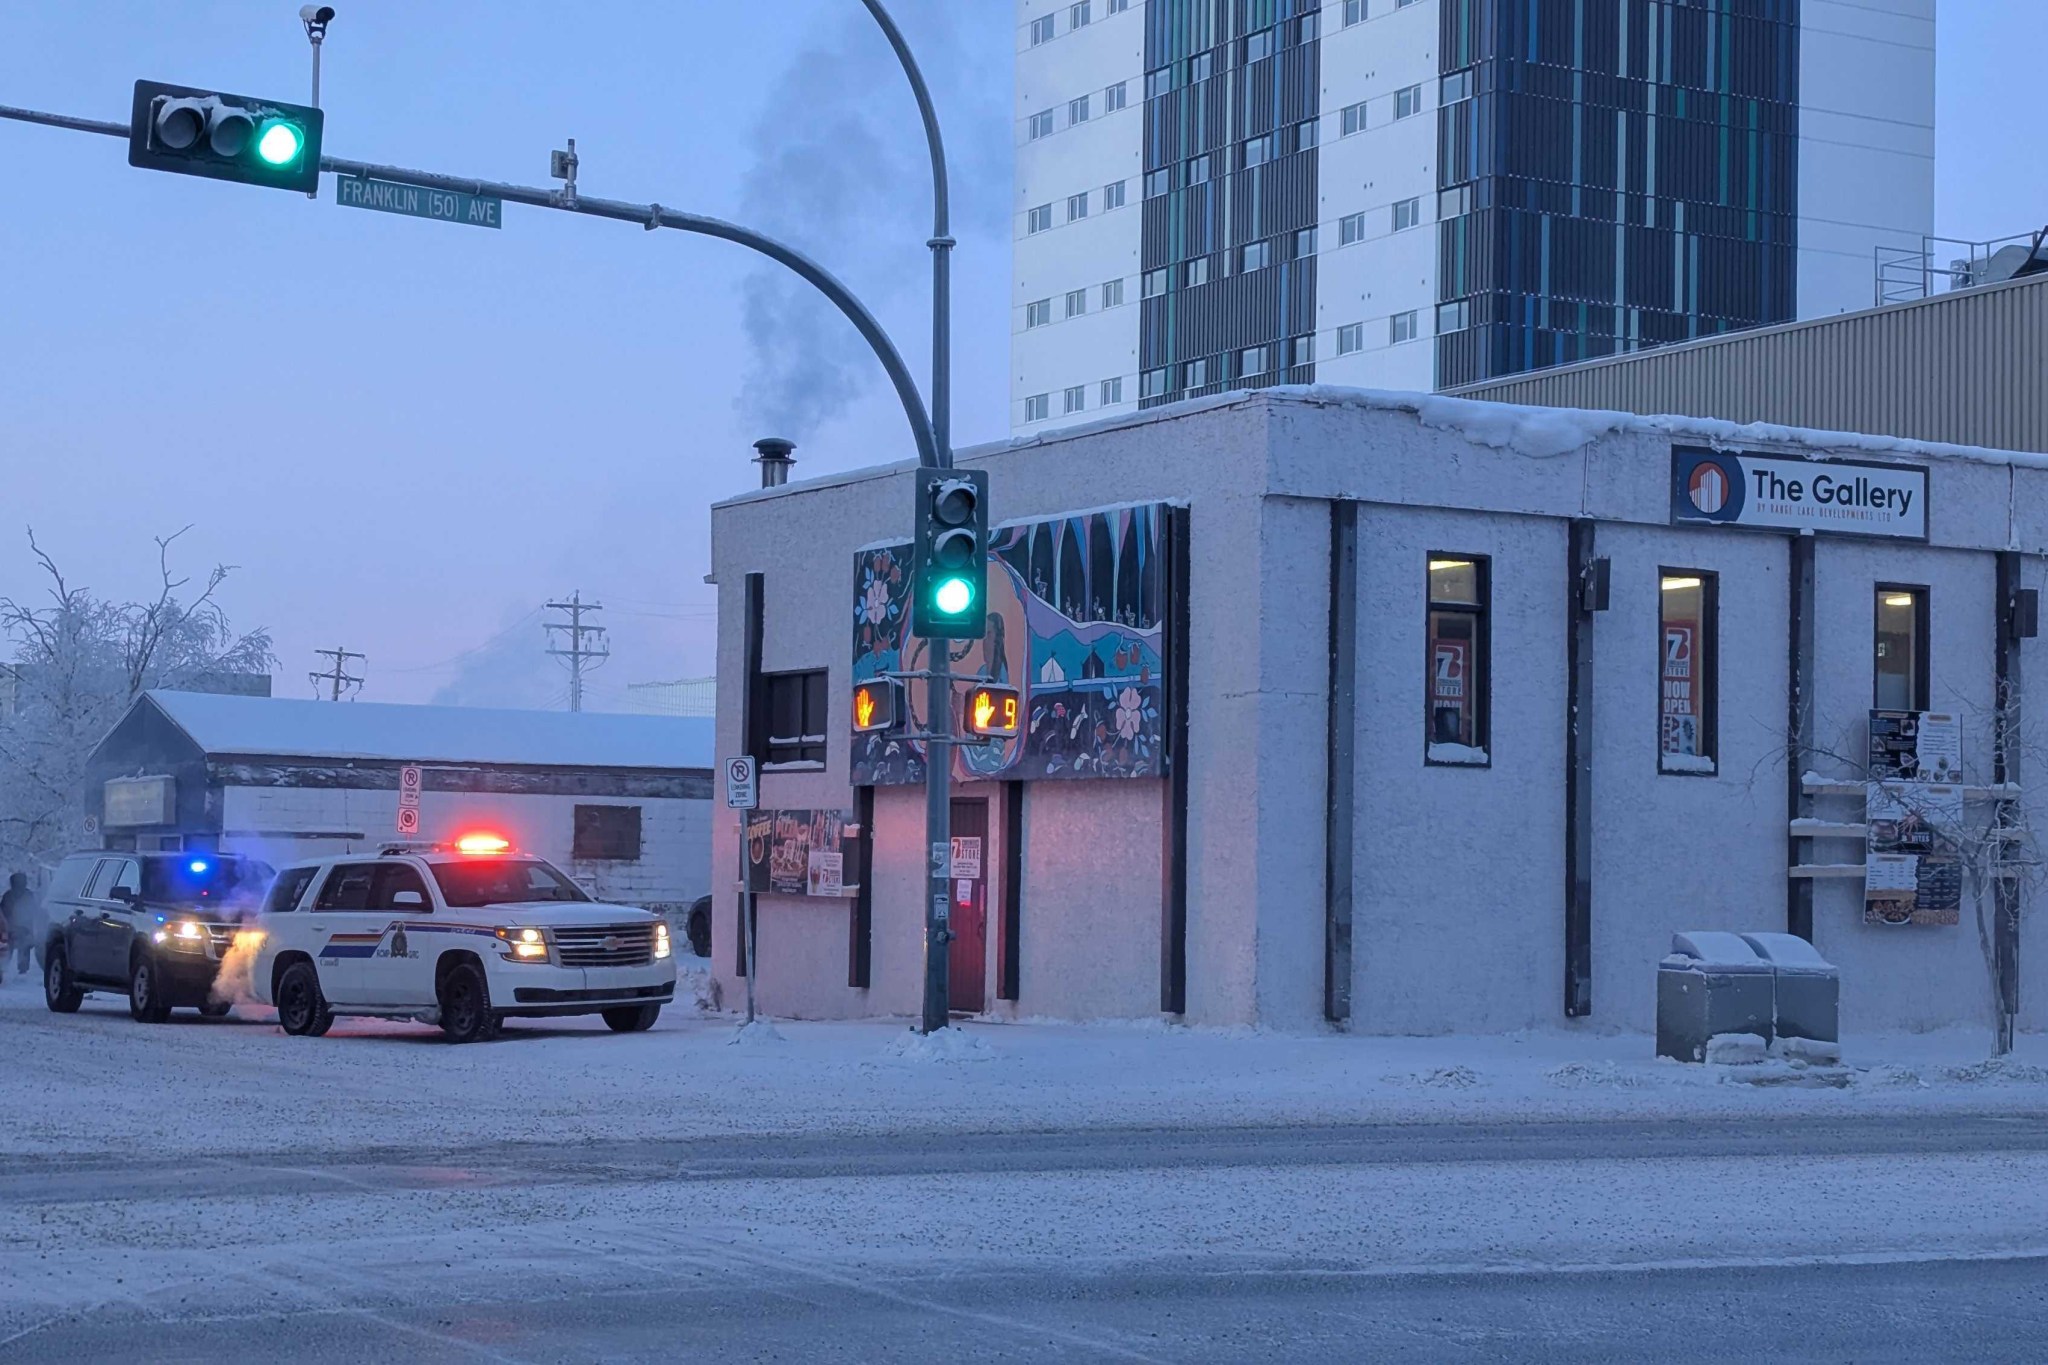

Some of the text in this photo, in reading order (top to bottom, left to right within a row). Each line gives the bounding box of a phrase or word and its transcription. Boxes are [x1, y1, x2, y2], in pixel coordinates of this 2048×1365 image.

[343, 179, 496, 224] FRANKLIN (50) AVE
[1752, 469, 1913, 518] The Gallery
[1757, 503, 1766, 513] BY
[1770, 503, 1793, 515] RANGE
[1797, 506, 1815, 517] LAKE
[1819, 507, 1874, 521] DEVELOPMENTS
[1663, 680, 1690, 698] NOW
[1004, 698, 1016, 730] 9
[1664, 699, 1691, 713] OPEN
[962, 849, 980, 860] STORE
[451, 927, 477, 935] POLICE
